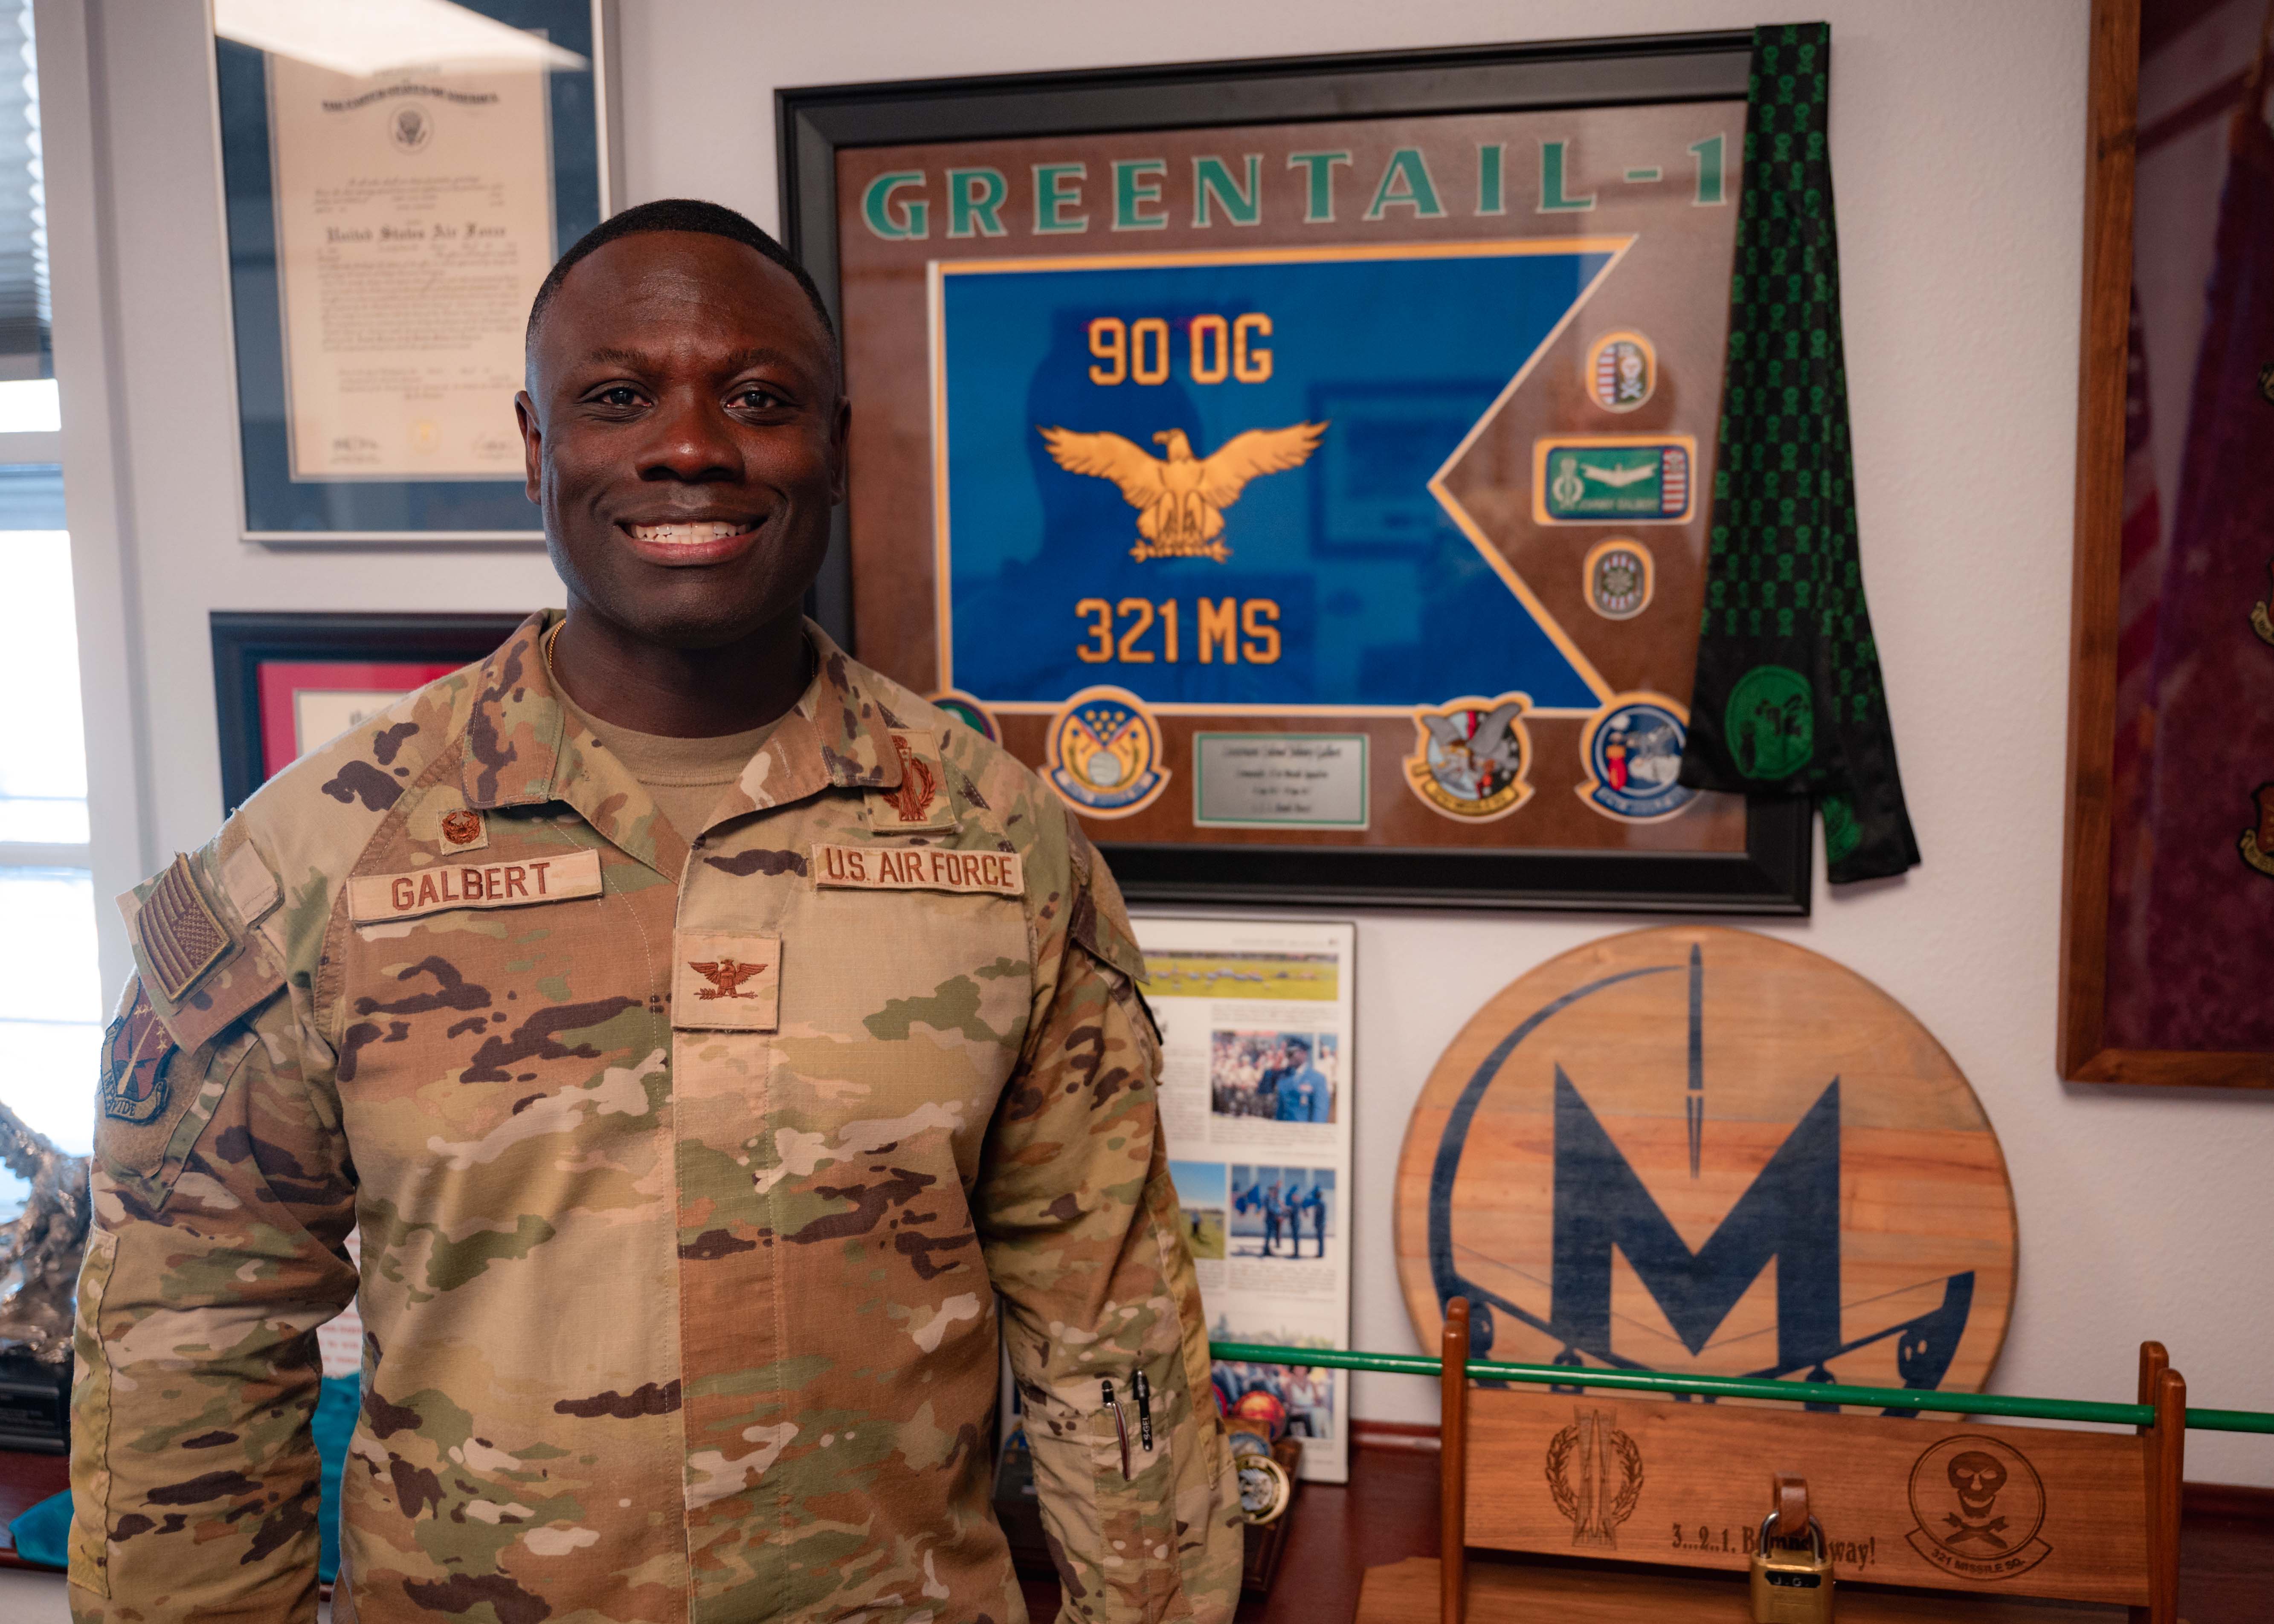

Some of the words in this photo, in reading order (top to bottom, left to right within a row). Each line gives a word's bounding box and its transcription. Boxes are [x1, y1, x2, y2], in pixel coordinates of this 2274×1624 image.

[862, 131, 1726, 240] GREENTAIL-1
[1088, 317, 1170, 386] 90
[1189, 312, 1273, 385] OG
[1075, 597, 1179, 663] 321
[1197, 596, 1281, 665] MS
[392, 862, 550, 911] GALBERT
[825, 847, 871, 882] U.S.
[879, 852, 925, 883] AIR
[930, 852, 1014, 888] FORCE
[1827, 1536, 1876, 1571] way!
[1931, 1548, 1952, 1566] 321
[1955, 1560, 2004, 1573] MISSILE
